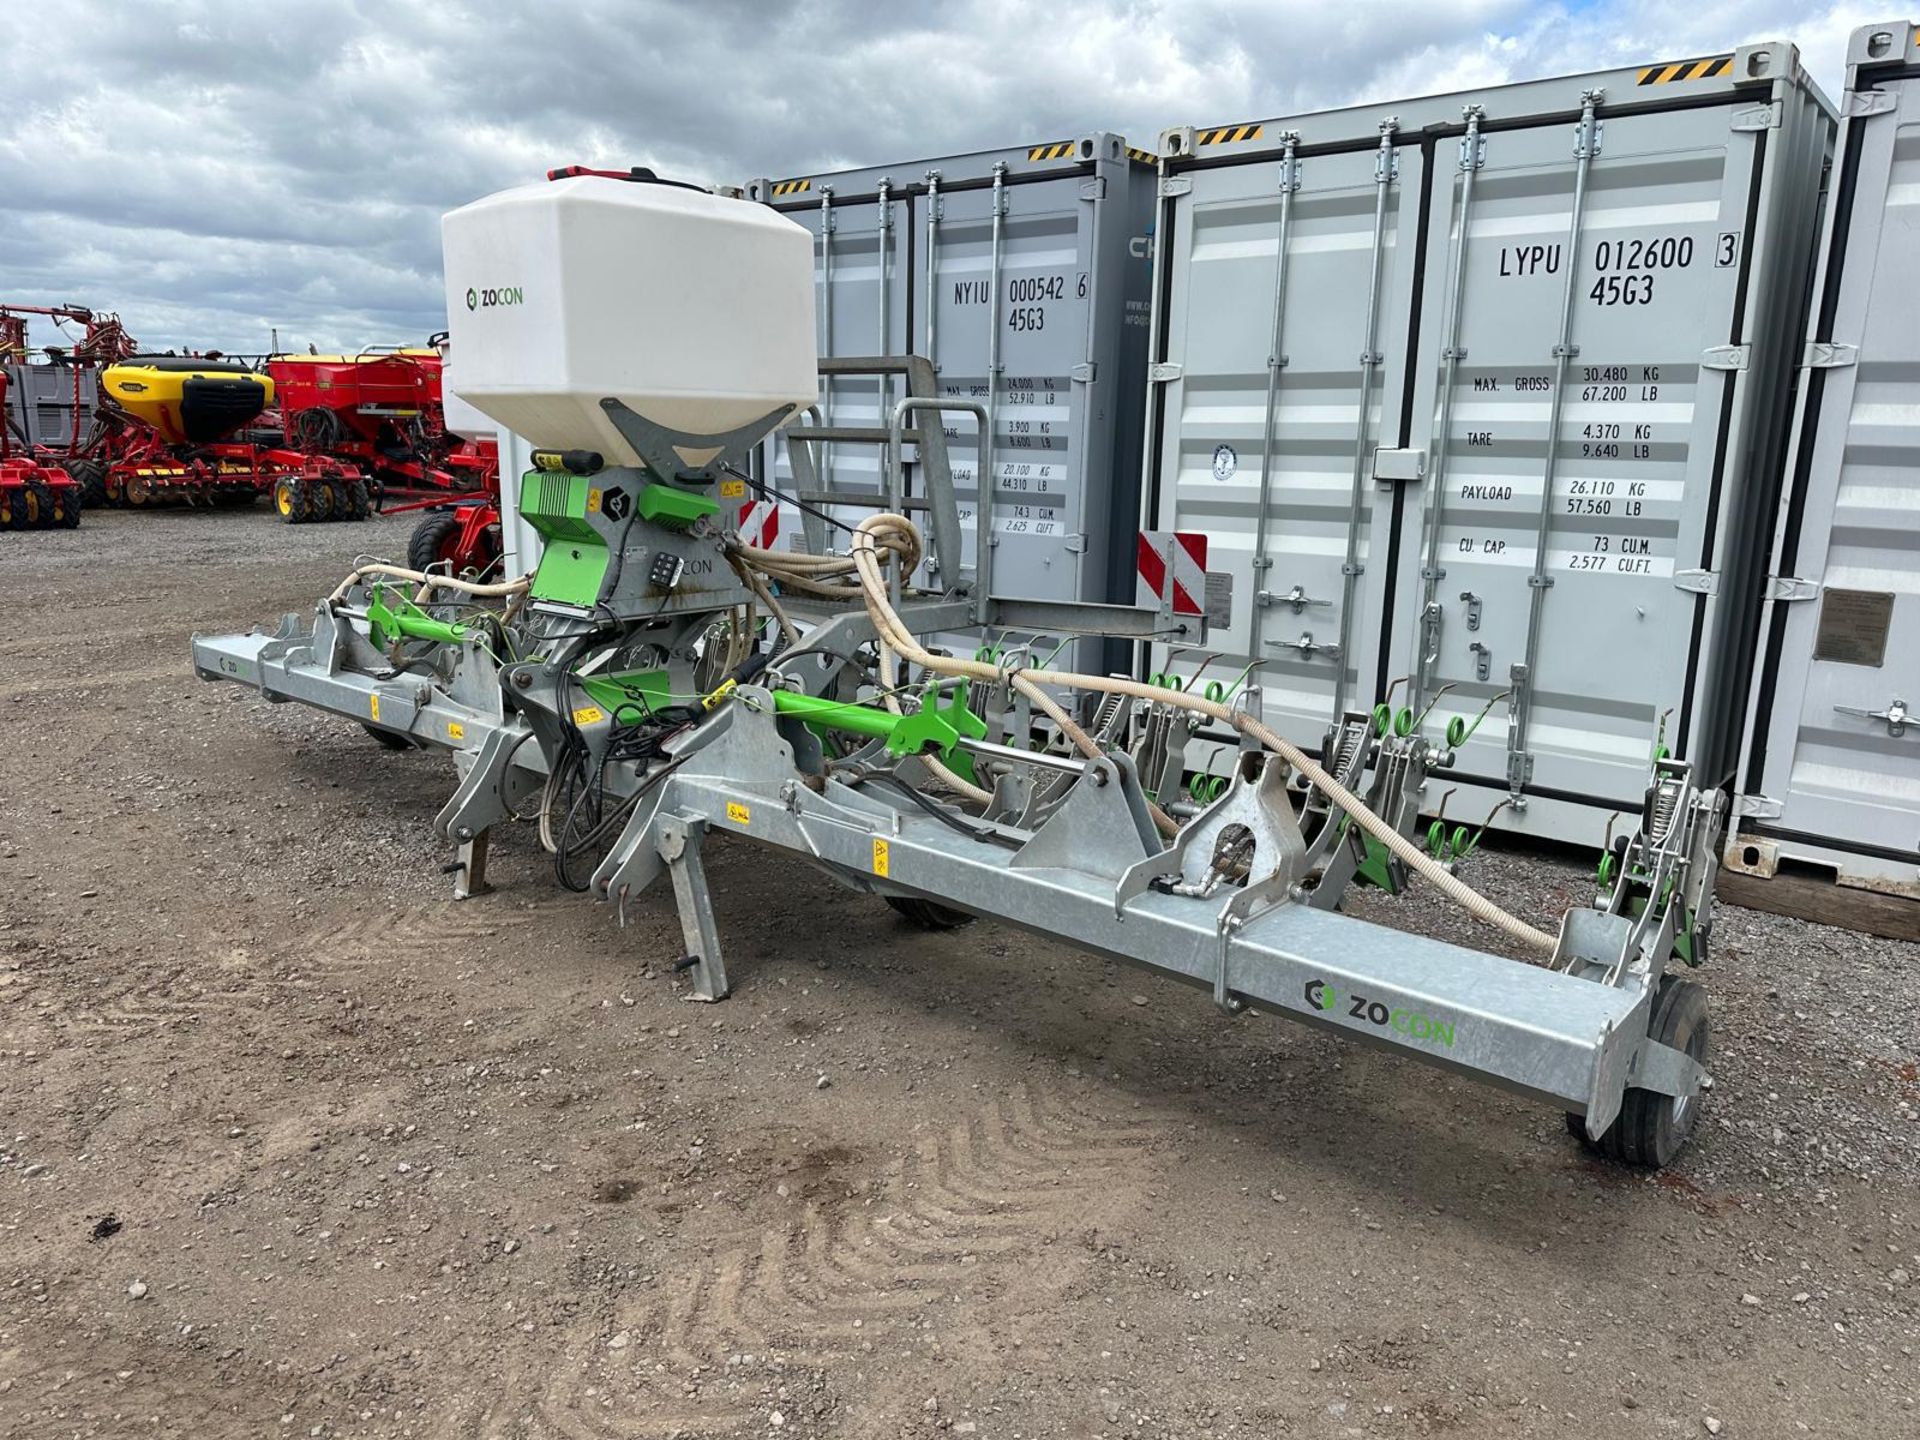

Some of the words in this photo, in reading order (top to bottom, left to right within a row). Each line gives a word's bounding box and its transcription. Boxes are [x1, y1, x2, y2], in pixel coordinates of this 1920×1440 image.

[1500, 244, 1561, 276] LYPU
[1595, 236, 1694, 271] 012600
[1719, 234, 1736, 266] 3
[481, 287, 523, 307] ZOCON
[954, 281, 989, 305] NYIU
[1009, 276, 1064, 303] 000542
[1078, 274, 1087, 298] 6
[1590, 274, 1654, 306] 45G3
[1009, 308, 1044, 331] 45G3
[1583, 367, 1628, 383] 30.480
[1643, 367, 1659, 381] KG
[970, 385, 990, 397] GROSS
[1008, 378, 1034, 391] 24.000
[1043, 378, 1055, 390] KG
[1475, 378, 1500, 392] MAX.
[1515, 377, 1549, 391] GROSS
[1009, 393, 1034, 405] 52.910
[1045, 393, 1055, 405] LB
[1582, 386, 1627, 401] 67.200
[1642, 387, 1658, 401] LB
[1009, 421, 1030, 433] 3.900
[1040, 421, 1050, 434] KG
[1583, 424, 1620, 439] 4.370
[1635, 425, 1651, 440] KG
[1010, 436, 1031, 448] 8.600
[1041, 437, 1052, 449] LB
[1467, 432, 1493, 446] TARE
[1583, 444, 1619, 458] 9.640
[1634, 444, 1650, 459] LB
[952, 469, 972, 480] LOAD
[1004, 464, 1030, 476] 20.100
[1040, 465, 1050, 477] KG
[1002, 478, 1027, 490] 44.310
[1038, 480, 1047, 491] LB
[1570, 480, 1614, 495] 26.110
[1628, 482, 1645, 496] KG
[1461, 485, 1512, 500] PAYLOAD
[1014, 506, 1030, 518] 74.3
[1567, 499, 1611, 515] 57.560
[1626, 501, 1642, 516] LB
[1006, 520, 1027, 532] 2.625
[1459, 538, 1474, 553] CU.
[1484, 539, 1506, 554] CAP.
[1594, 536, 1609, 551] 73
[1621, 538, 1651, 554] CU.M.
[681, 560, 712, 576] CON
[1569, 555, 1606, 570] 2.577
[1618, 557, 1651, 573] CU.FT.
[1349, 995, 1455, 1048] ZOCON
